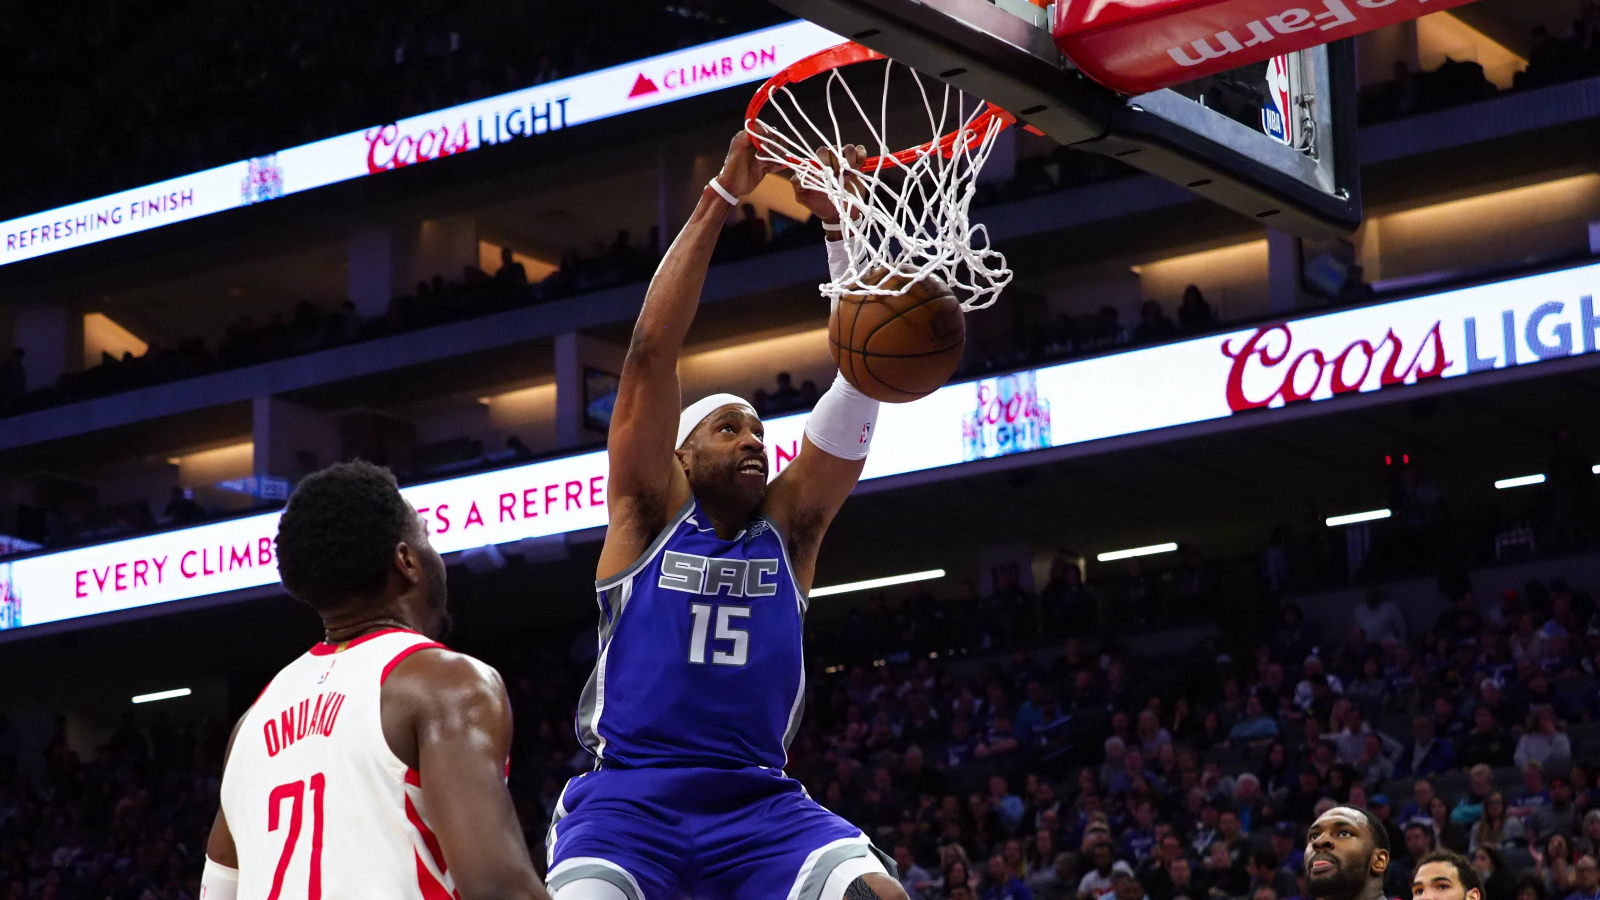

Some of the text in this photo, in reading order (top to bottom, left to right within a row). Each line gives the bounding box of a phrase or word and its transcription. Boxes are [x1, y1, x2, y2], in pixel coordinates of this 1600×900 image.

[663, 45, 776, 90] CLIMB ON
[365, 95, 571, 175] Coors LIGHT
[1265, 107, 1282, 134] NBA
[6, 188, 193, 252] REFRESHING FINISH
[1220, 323, 1454, 412] Coors
[75, 555, 168, 598] EVERY
[180, 536, 272, 579] CLIMB
[464, 500, 485, 530] A
[499, 475, 605, 523] REFRE
[658, 550, 778, 598] SAC
[688, 603, 750, 666] 15
[263, 691, 346, 758] ONUAKU
